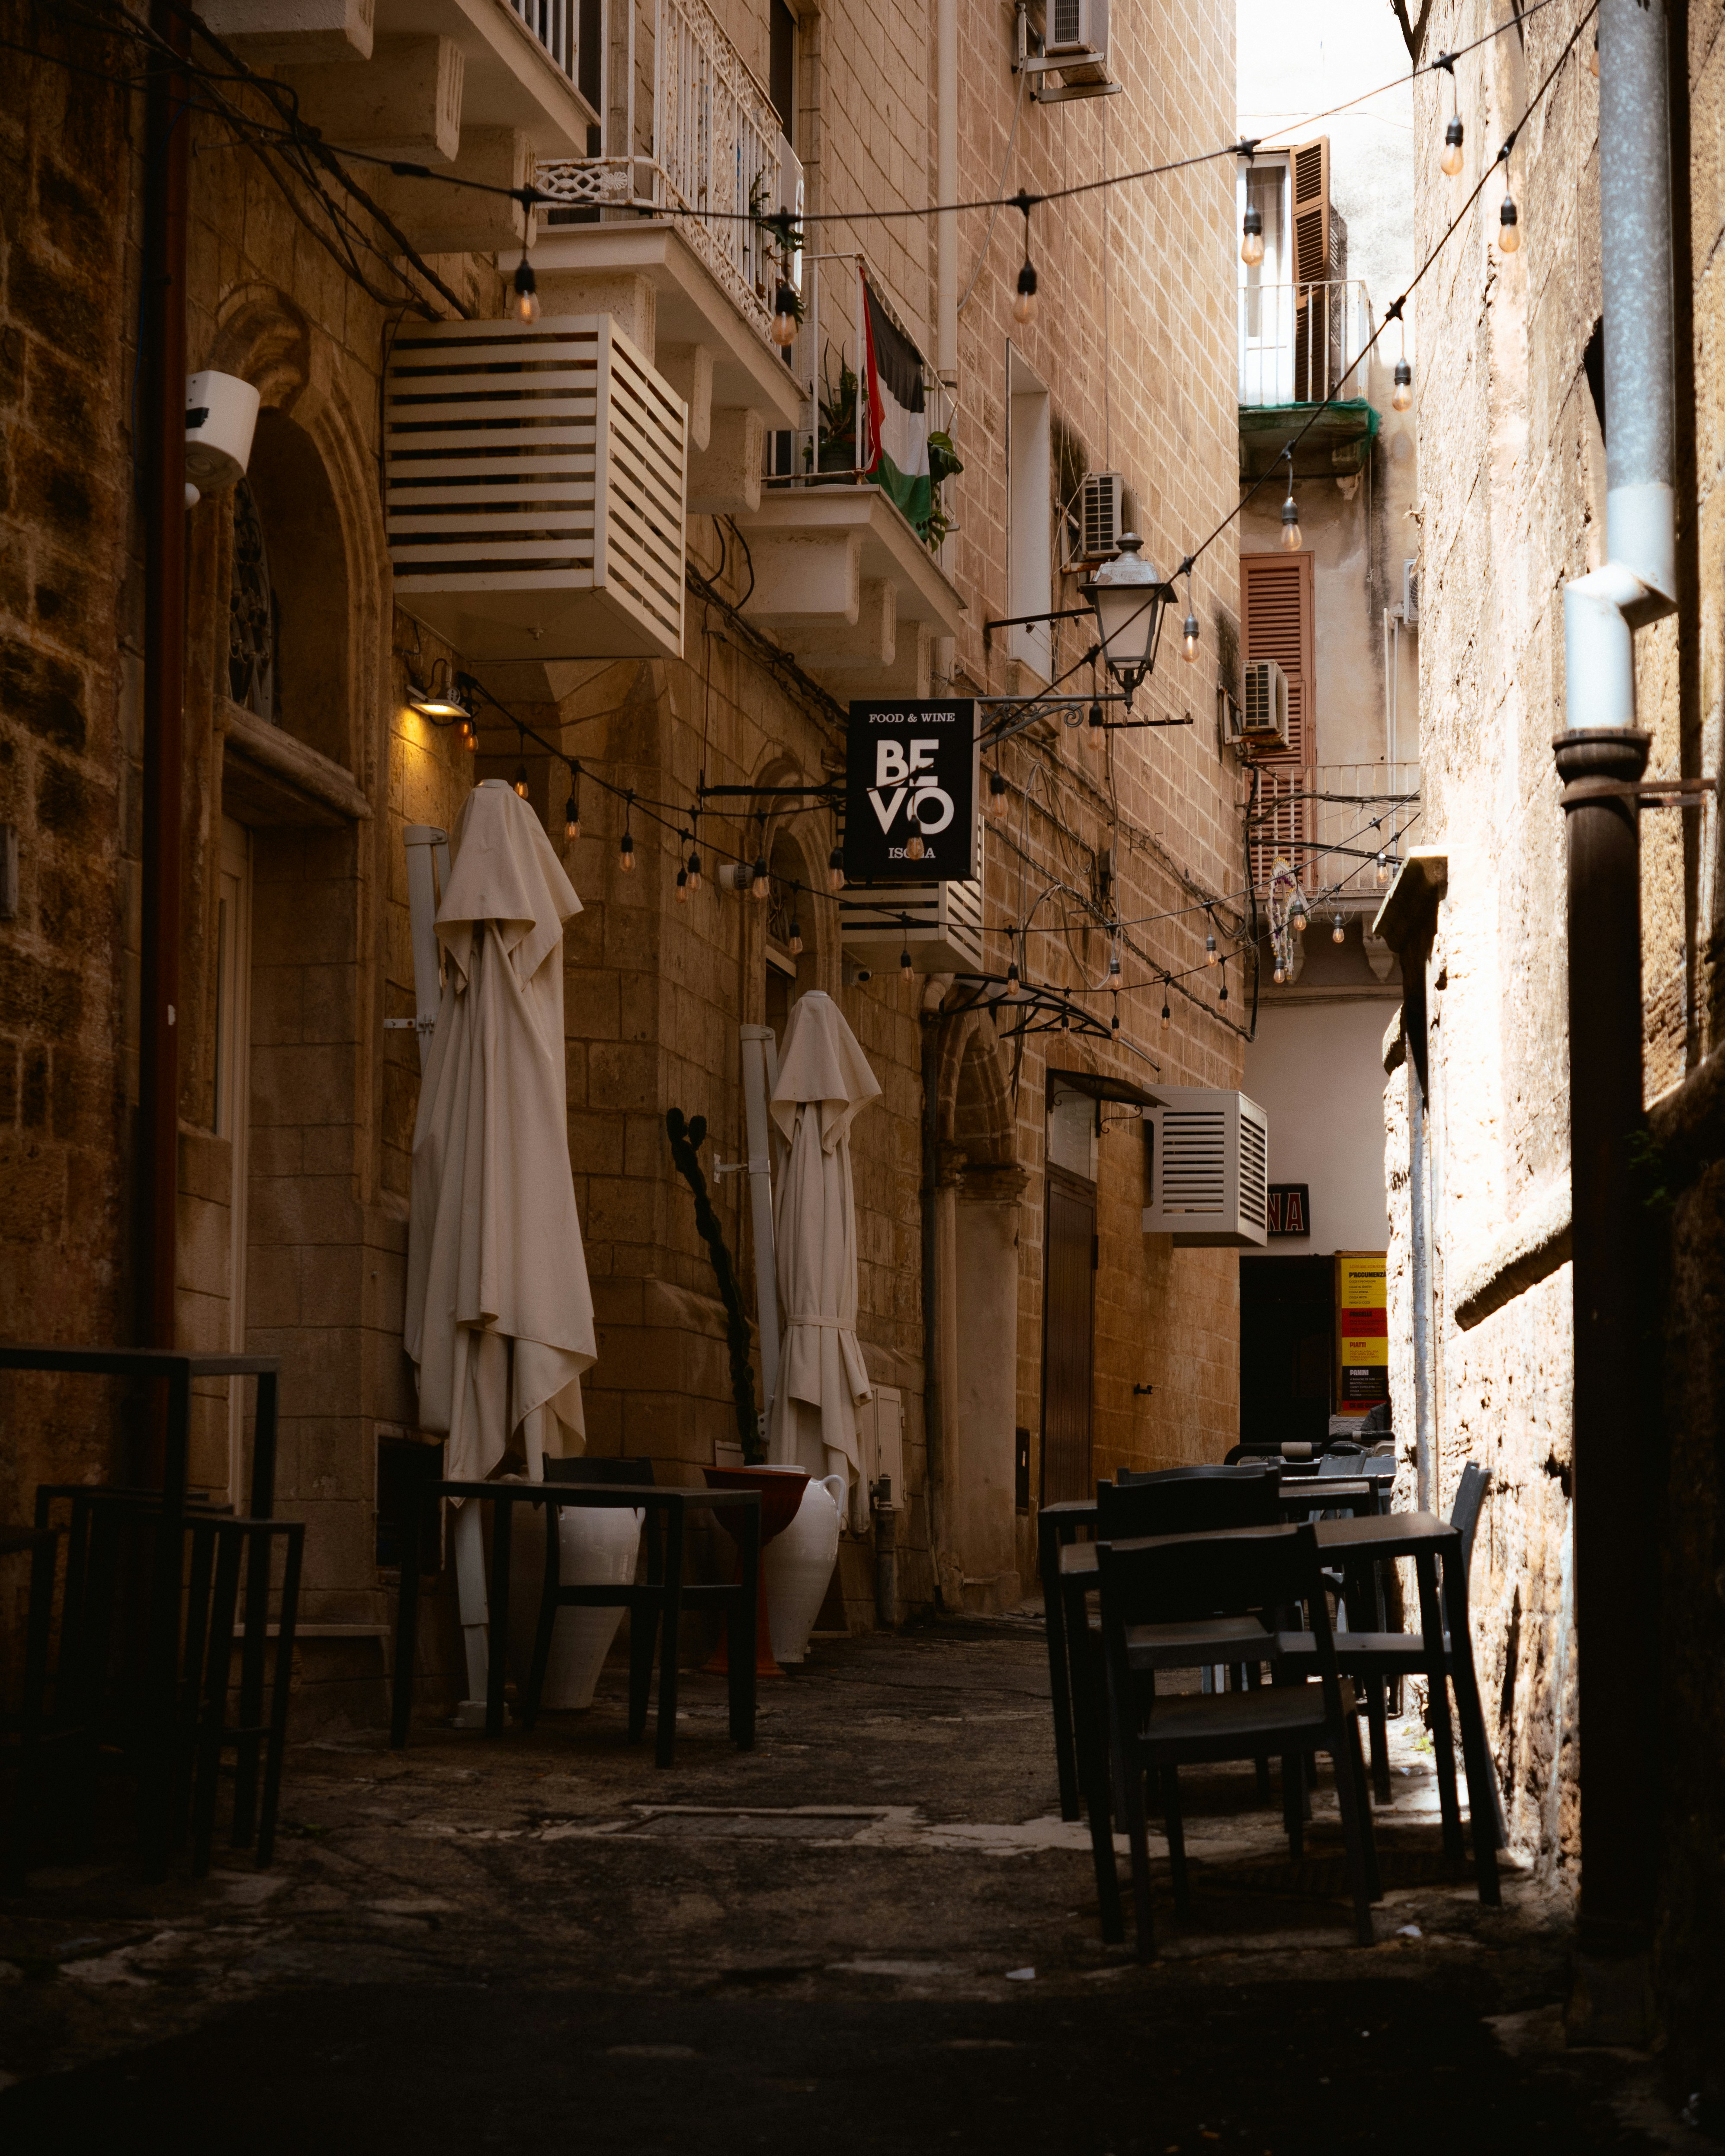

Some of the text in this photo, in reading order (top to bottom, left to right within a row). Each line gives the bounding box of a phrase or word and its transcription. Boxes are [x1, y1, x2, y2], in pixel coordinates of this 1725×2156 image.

[869, 713, 955, 723] FOOD & WINE
[876, 739, 939, 787] BE
[866, 787, 954, 835] VO
[888, 848, 936, 859] ISA
